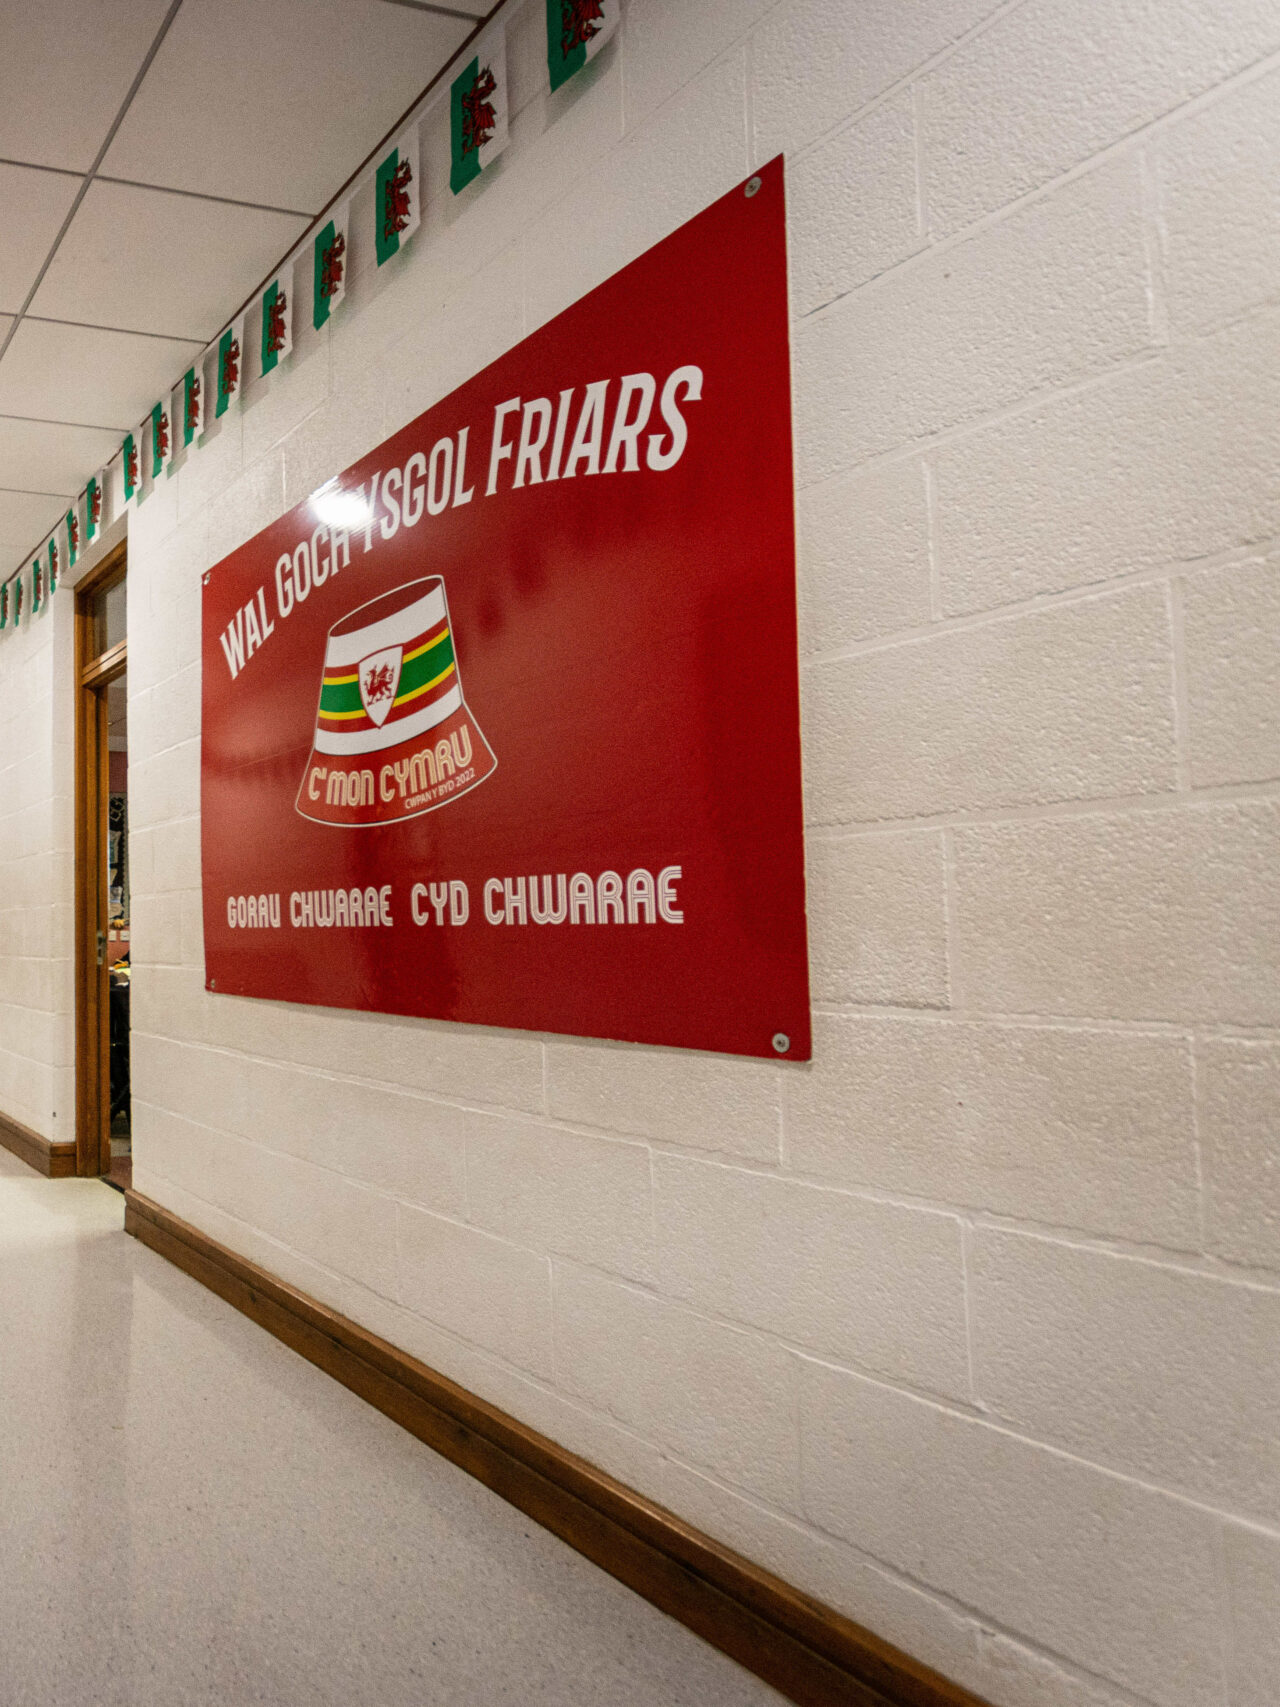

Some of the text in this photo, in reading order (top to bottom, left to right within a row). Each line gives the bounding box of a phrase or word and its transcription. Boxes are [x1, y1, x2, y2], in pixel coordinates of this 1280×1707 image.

[219, 365, 704, 681] WAL GOCH YSGOL FRIARS
[380, 724, 473, 803] CYMRU
[438, 780, 455, 796] BYD
[455, 767, 476, 787] 2022
[227, 865, 684, 928] GORAU CHWARAE CYD CHWARAE
